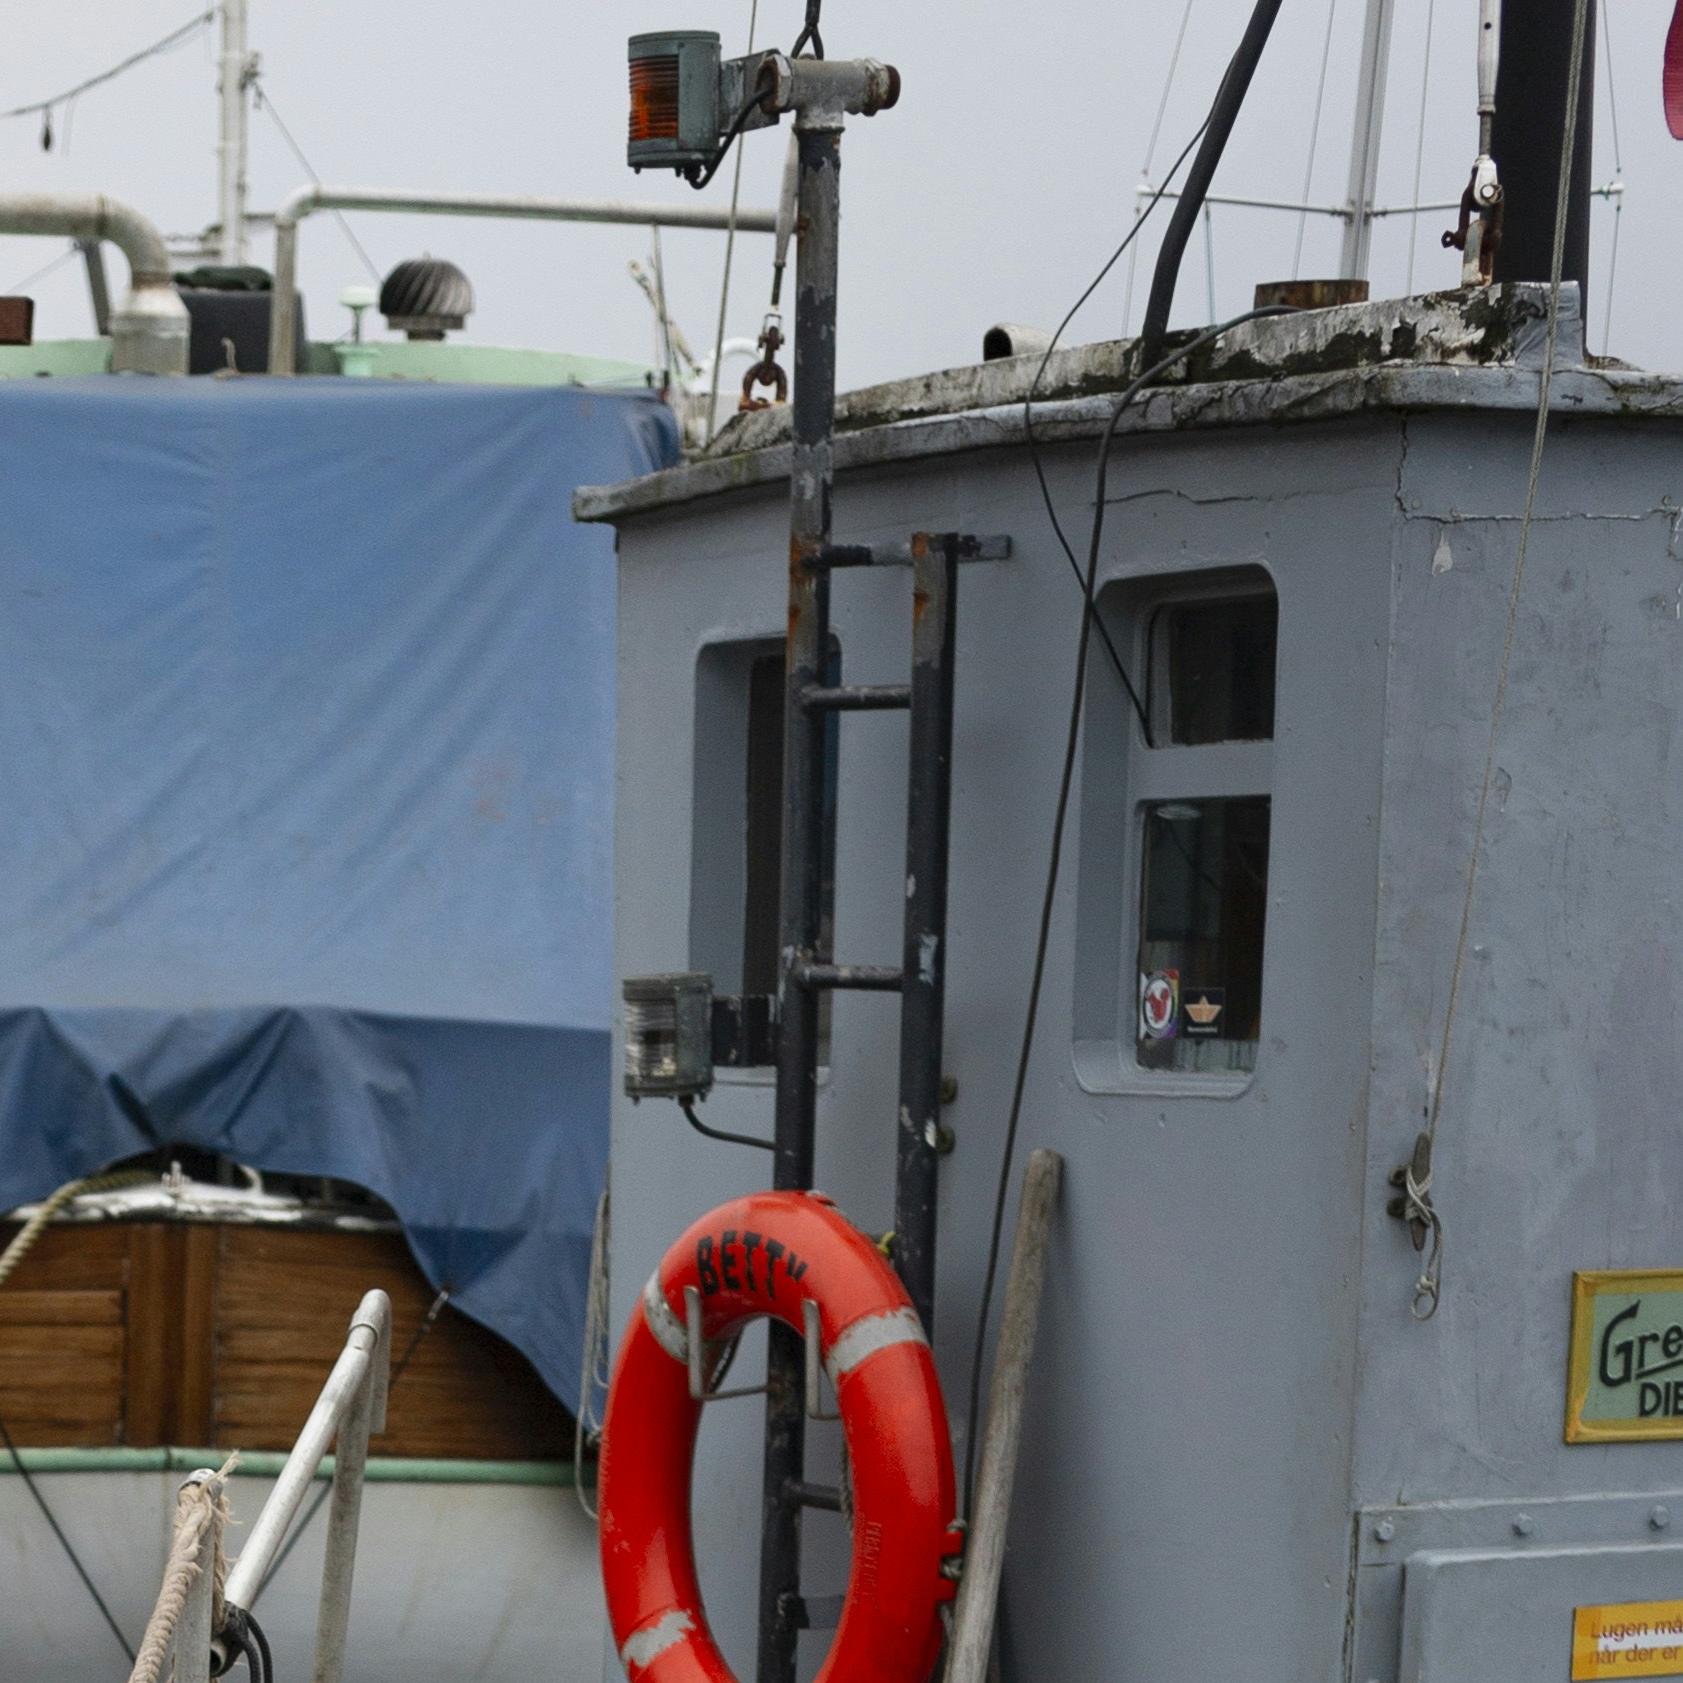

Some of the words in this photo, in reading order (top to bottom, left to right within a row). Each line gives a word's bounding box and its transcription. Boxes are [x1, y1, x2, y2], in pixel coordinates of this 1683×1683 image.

[1590, 1620, 1648, 1642] Lugen
[1589, 1644, 1621, 1664] når
[1625, 1643, 1657, 1662] der
[1661, 1646, 1681, 1661] er
